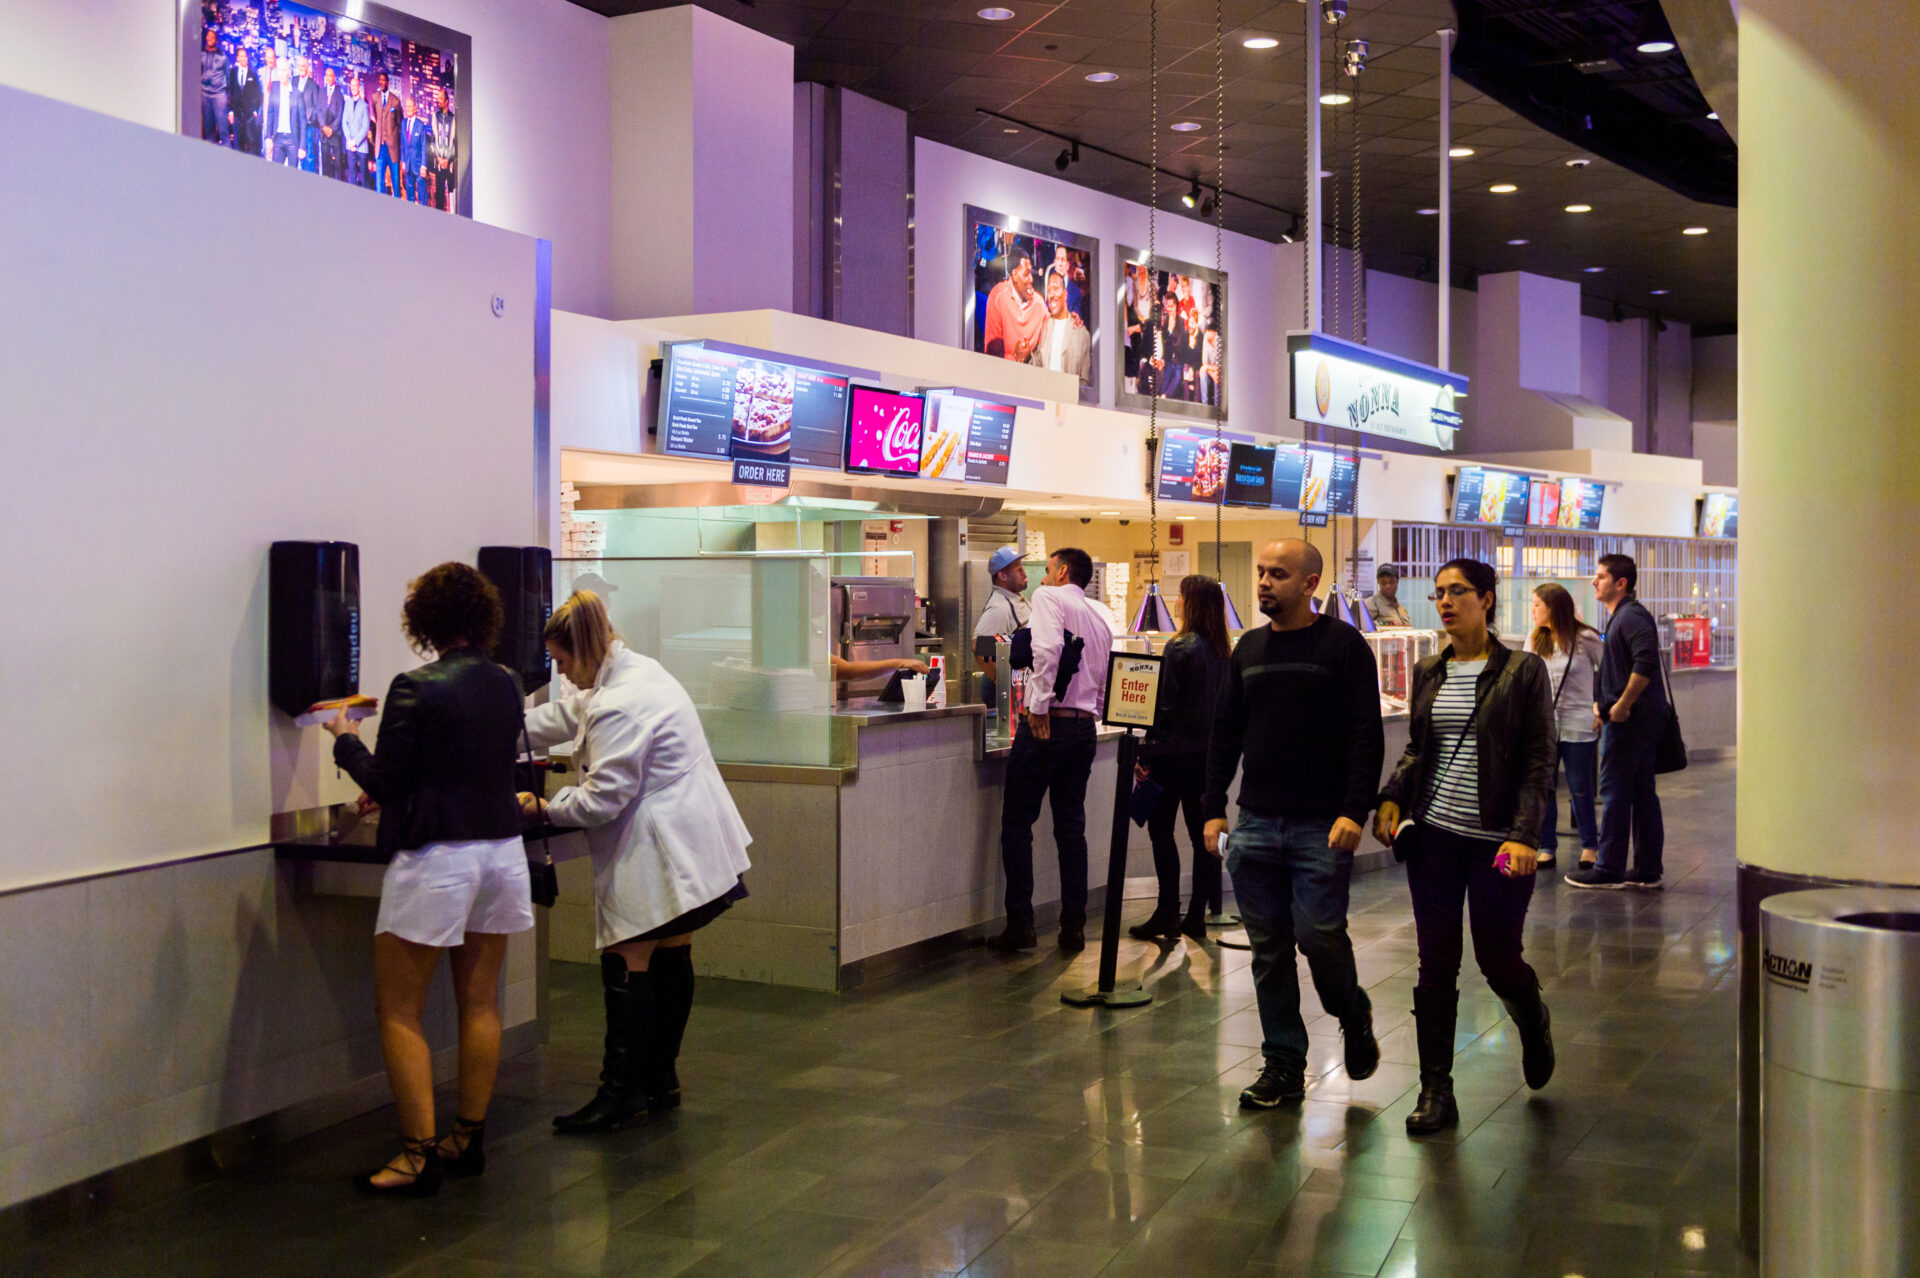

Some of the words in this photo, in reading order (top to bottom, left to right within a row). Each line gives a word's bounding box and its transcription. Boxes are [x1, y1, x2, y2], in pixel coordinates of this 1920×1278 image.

[495, 297, 504, 310] 24
[1347, 383, 1399, 428] NONNA
[738, 465, 764, 480] ORDER
[766, 468, 786, 482] HERE
[349, 612, 360, 682] napkins
[1129, 664, 1153, 672] NONNA
[1121, 678, 1149, 692] Enter
[1121, 690, 1146, 704] Here
[1762, 948, 1812, 978] ACTION
